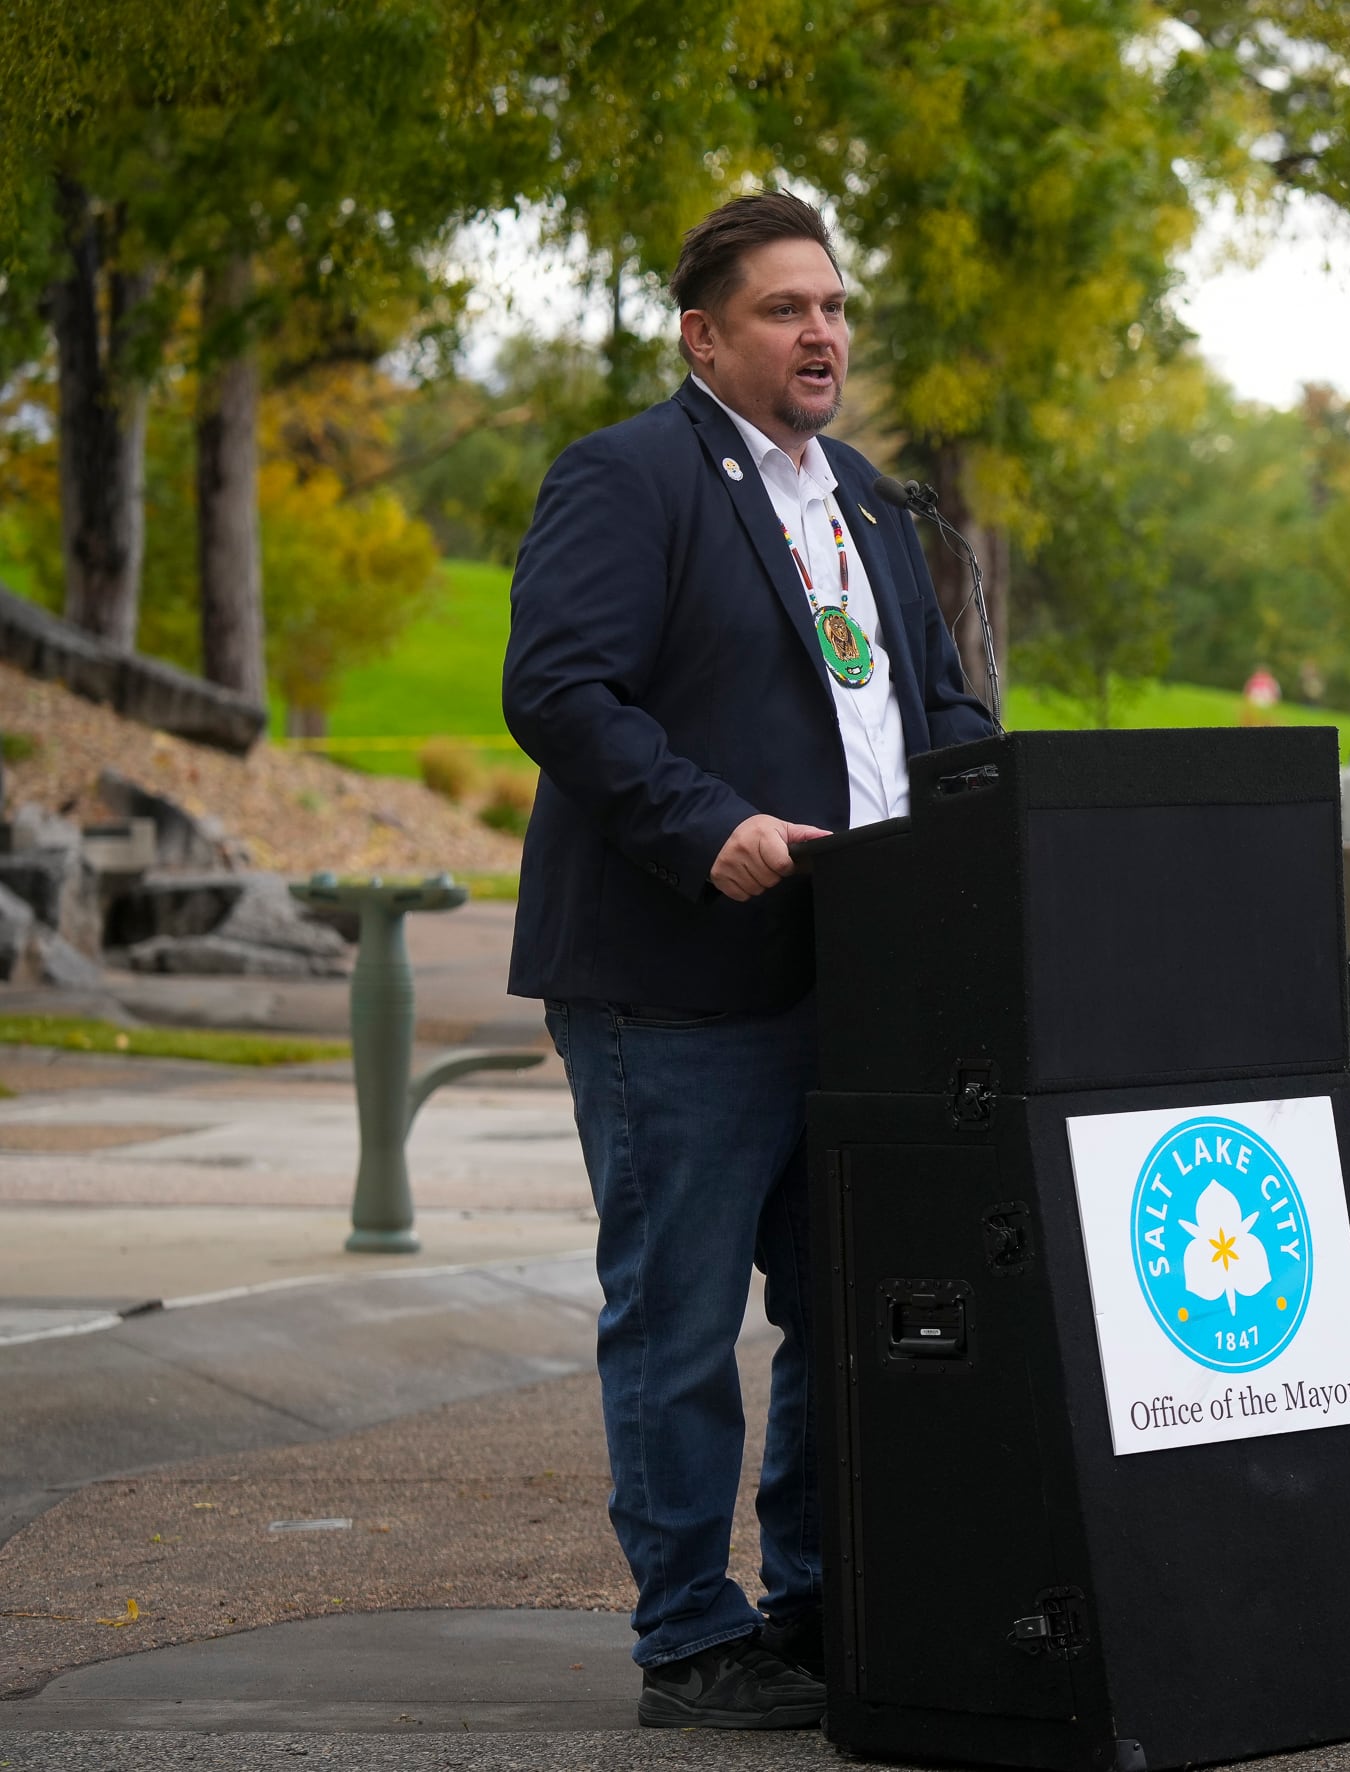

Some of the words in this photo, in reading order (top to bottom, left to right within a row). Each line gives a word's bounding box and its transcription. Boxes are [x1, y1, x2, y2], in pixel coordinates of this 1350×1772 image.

[1144, 1172, 1173, 1277] SALT
[1172, 1136, 1253, 1174] LAKE
[1260, 1174, 1301, 1261] CITY
[1214, 1325, 1259, 1352] 1847
[1130, 1395, 1204, 1431] Office
[1210, 1387, 1234, 1421] of
[1238, 1385, 1278, 1417] the
